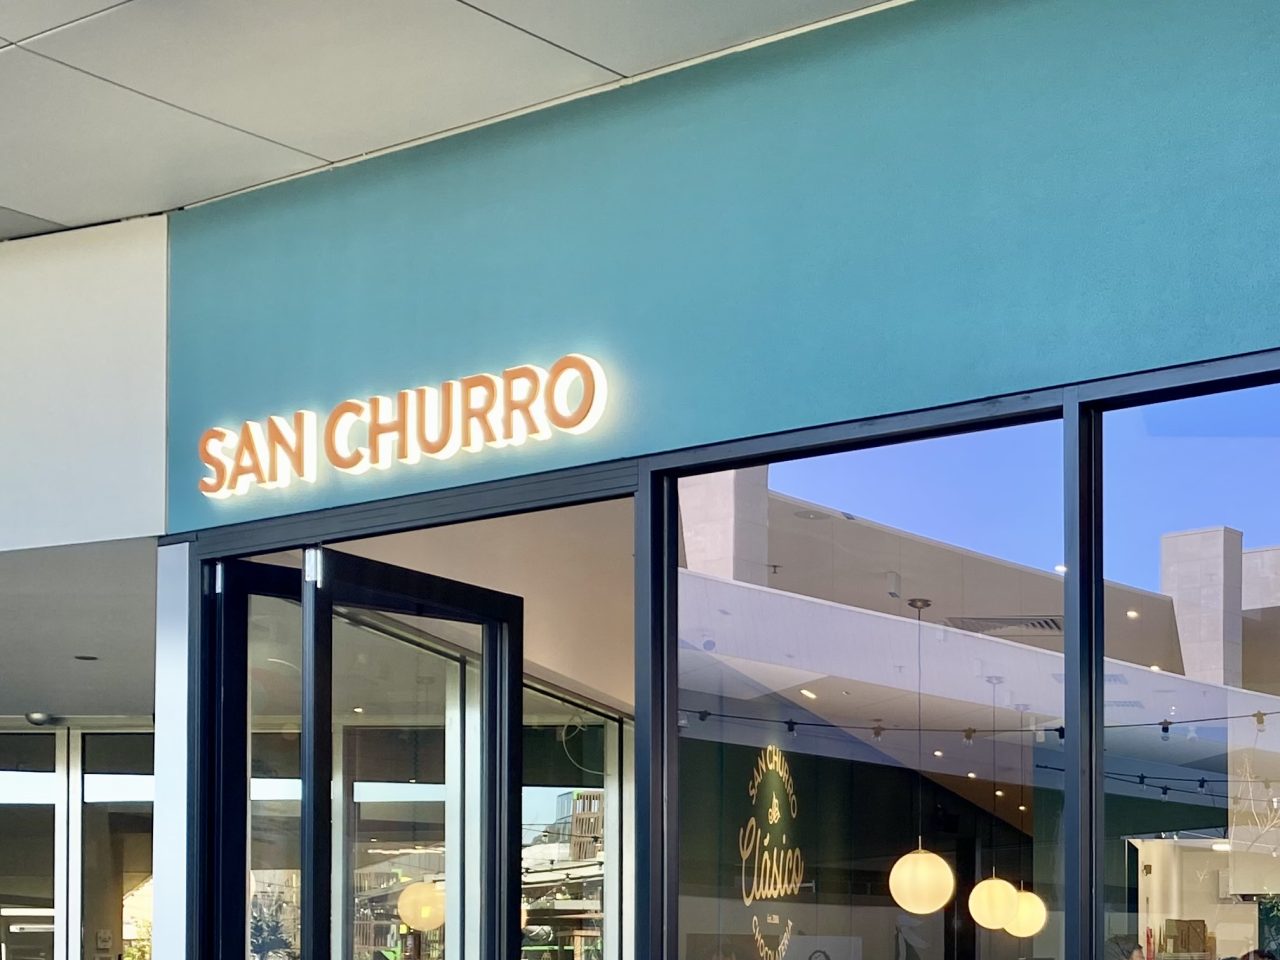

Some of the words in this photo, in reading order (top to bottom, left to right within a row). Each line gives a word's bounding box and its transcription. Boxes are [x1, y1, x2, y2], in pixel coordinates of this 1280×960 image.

[199, 411, 312, 495] SAN
[324, 354, 603, 471] CHURRO
[749, 752, 767, 804] SAN
[767, 745, 797, 818] CHURRO
